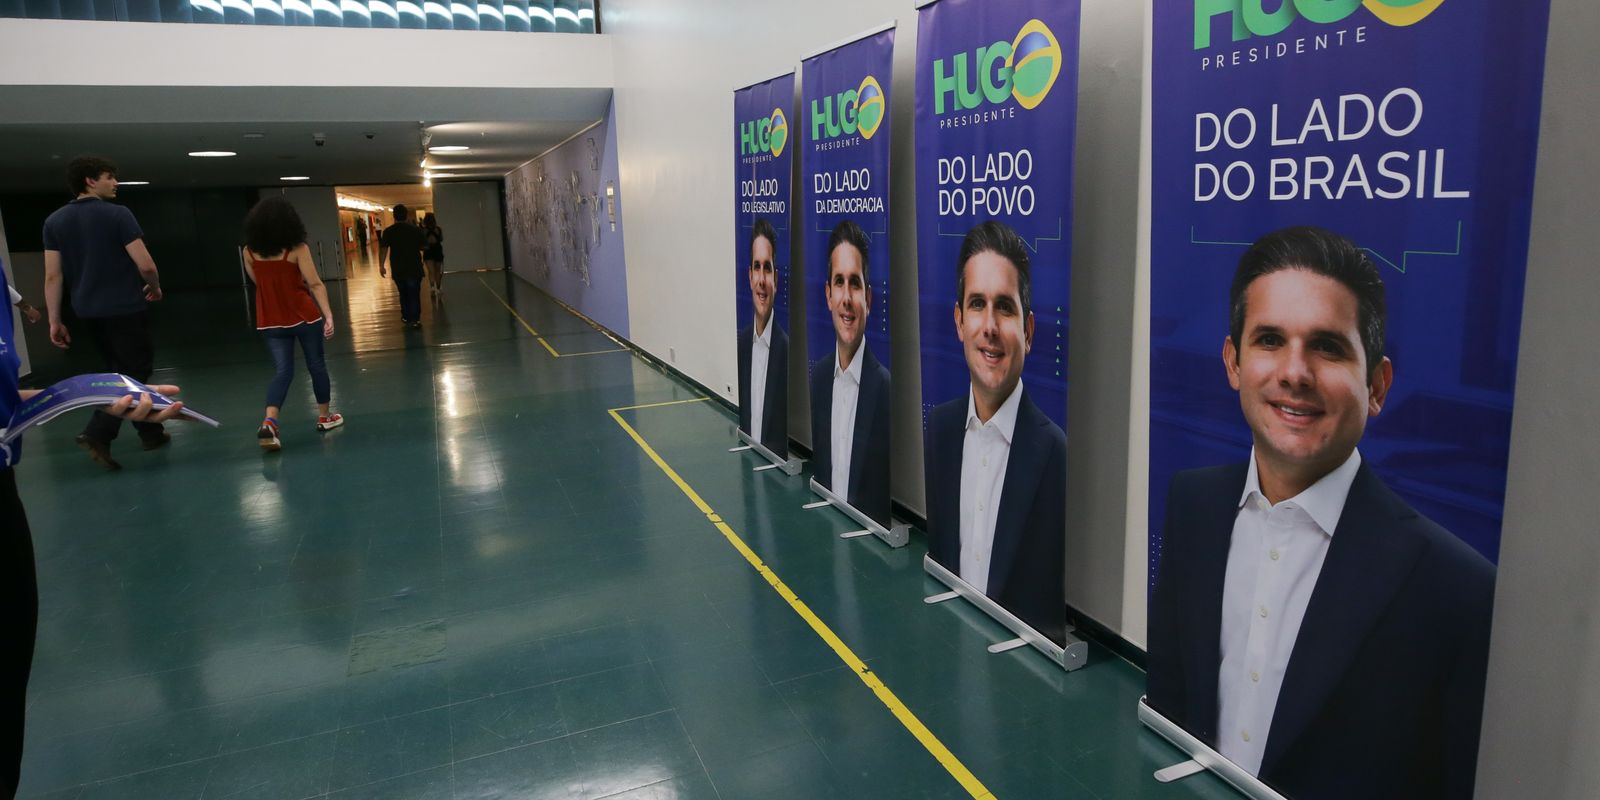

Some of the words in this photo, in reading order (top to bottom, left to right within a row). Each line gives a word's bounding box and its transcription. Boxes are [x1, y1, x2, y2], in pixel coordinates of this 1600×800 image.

[1202, 27, 1367, 71] PRESIDENTE
[933, 19, 1062, 114] HUGO
[811, 75, 885, 140] HUGO
[940, 107, 1015, 129] PRESIDENTE
[1195, 107, 1257, 152] DO
[1271, 87, 1423, 146] LADO
[741, 108, 788, 157] HUGO
[815, 137, 860, 152] PRESIDENTE
[743, 154, 772, 164] PRESIDENTE
[938, 156, 966, 185] DO
[972, 149, 1033, 182] LADO
[741, 181, 754, 197] DO
[754, 178, 778, 197] LADO
[814, 172, 832, 193] DO
[835, 168, 870, 192] LADO
[1194, 161, 1255, 202] DO
[1269, 149, 1470, 201] BRASIL
[742, 201, 751, 213] DO
[751, 201, 785, 214] LEGISLATIVO
[816, 200, 826, 213] DA
[827, 197, 884, 213] DEMOCRACIA
[939, 188, 967, 216] DO
[972, 185, 1035, 216] POVO
